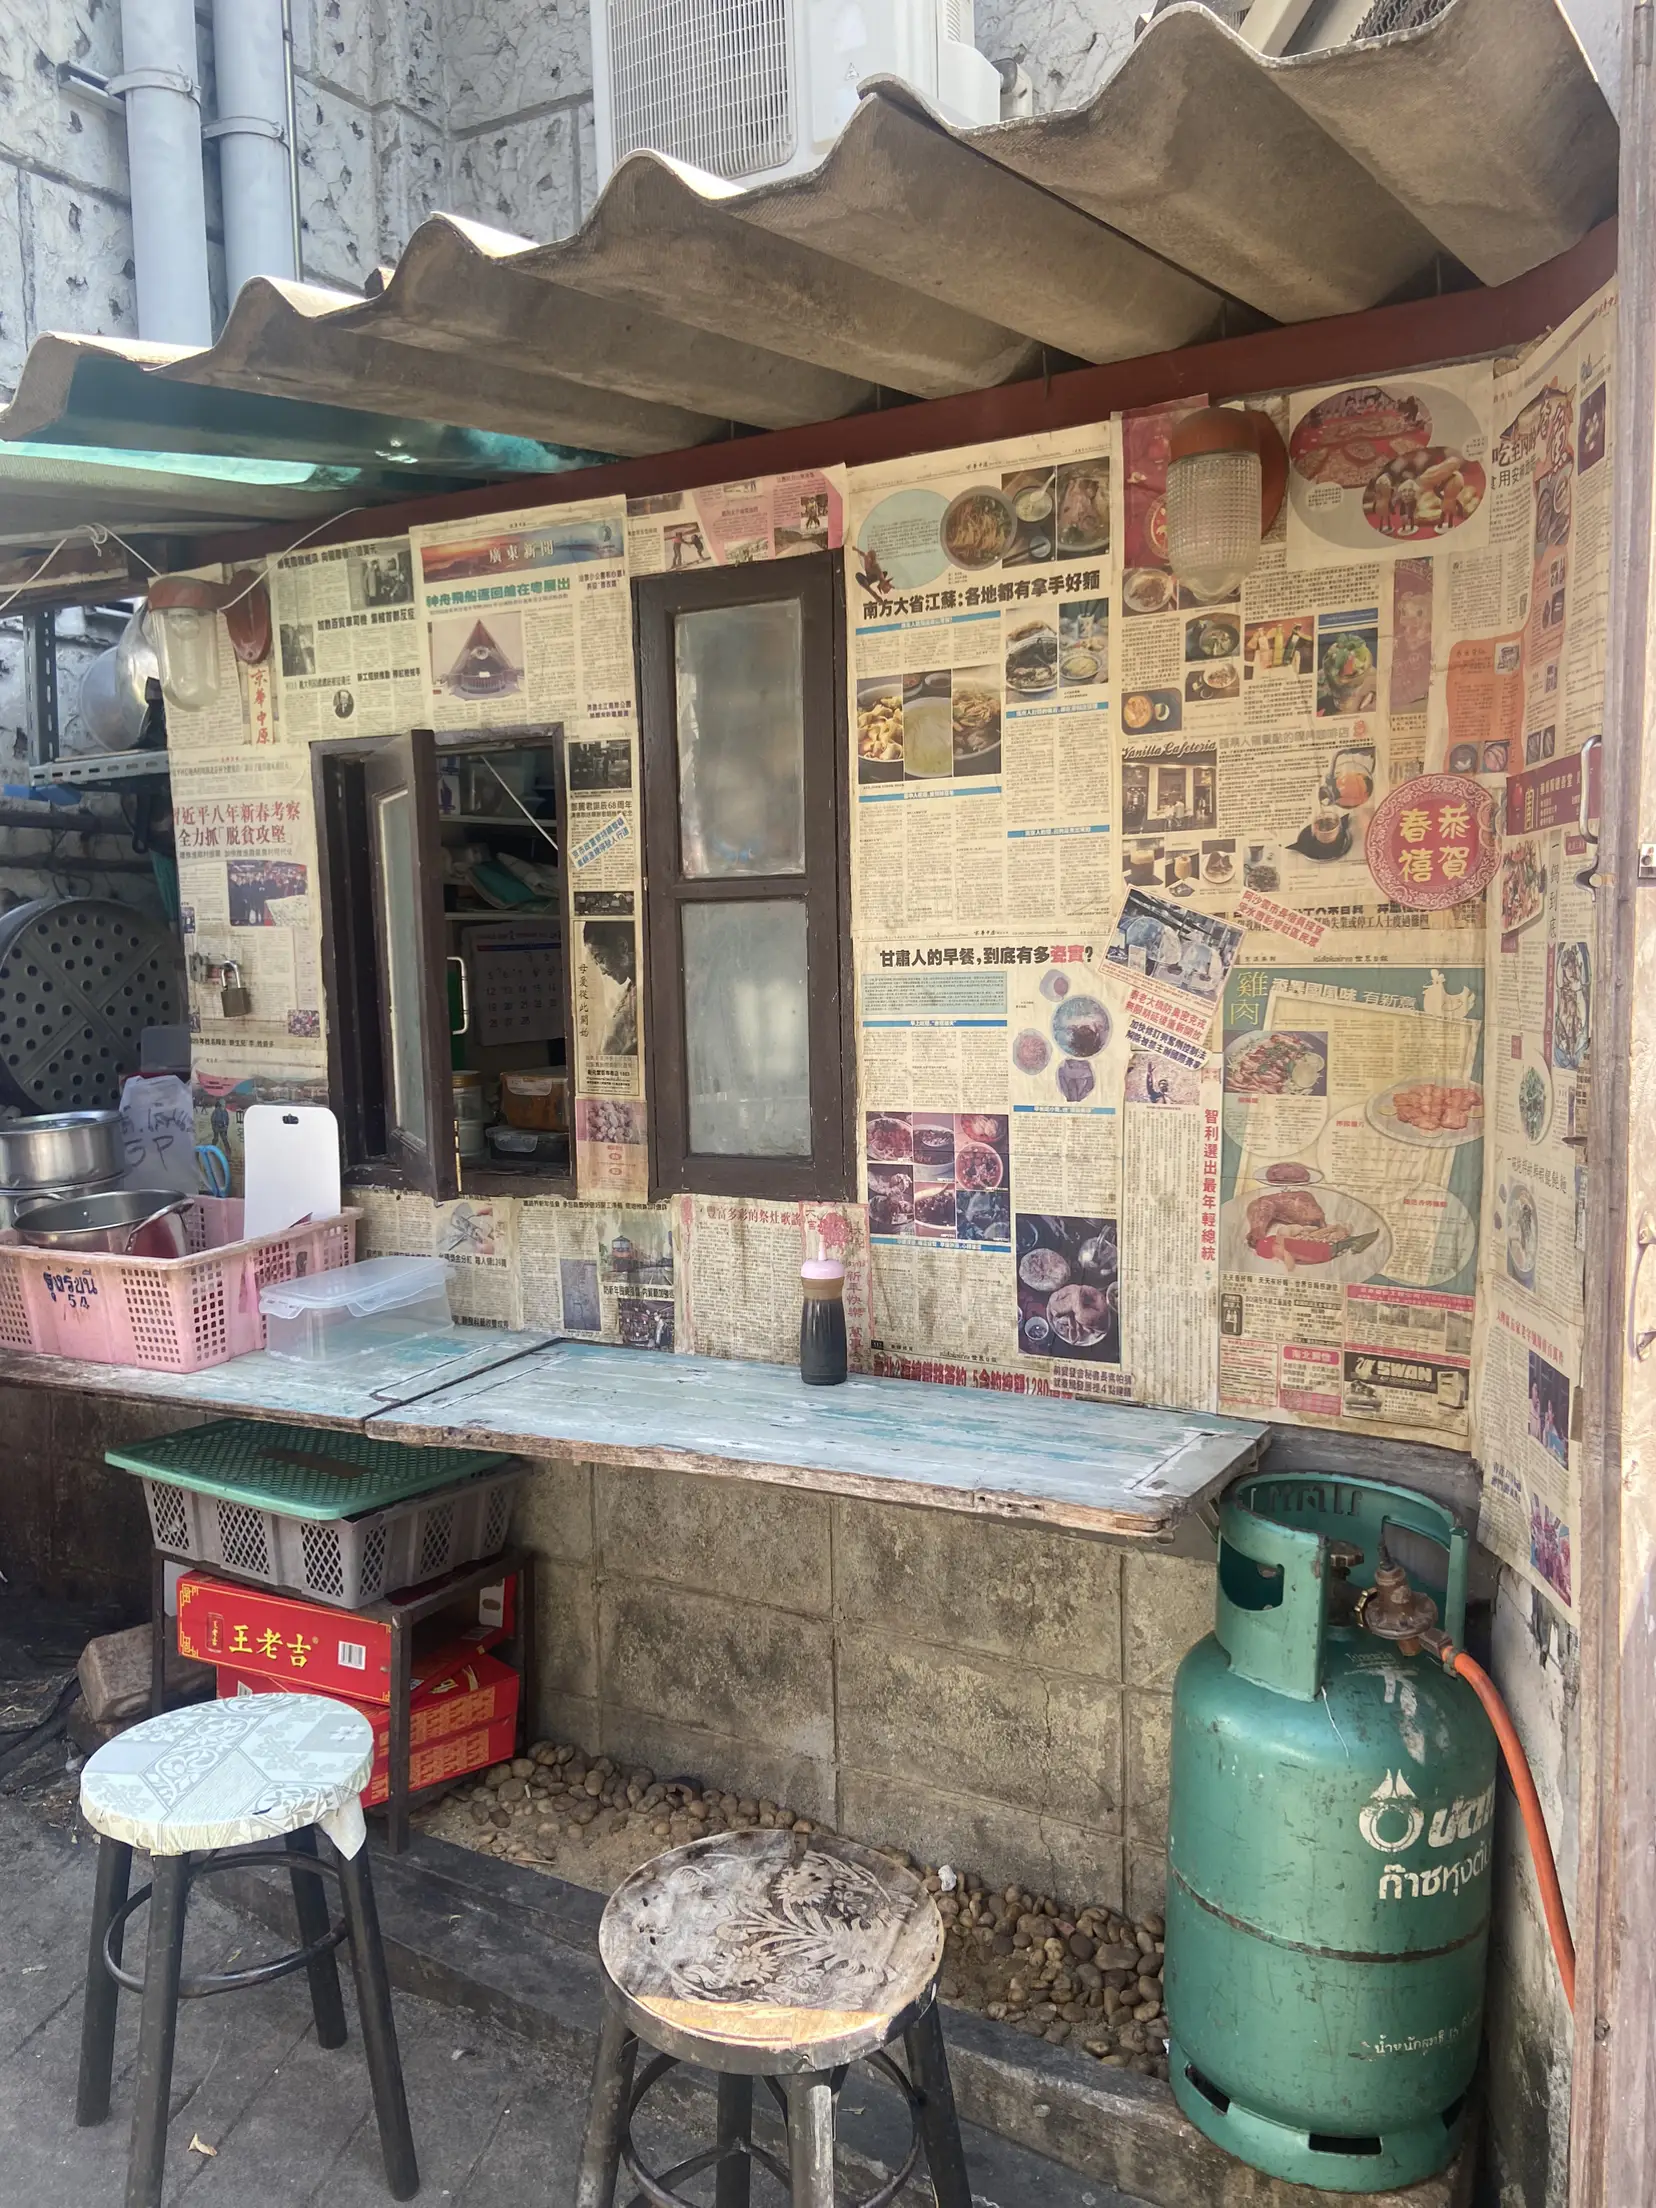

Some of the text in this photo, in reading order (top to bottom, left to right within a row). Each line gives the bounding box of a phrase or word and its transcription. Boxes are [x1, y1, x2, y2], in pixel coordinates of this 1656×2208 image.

[489, 540, 554, 563] 廣東新聞
[249, 668, 270, 745] 京華中原
[1122, 738, 1217, 759] Vanilla Cafeteria
[1229, 971, 1269, 1026] 雞肉
[1200, 1108, 1219, 1262] 智利選出最年輕總統
[1376, 1360, 1433, 1383] SWAN
[228, 1624, 312, 1668] 王老吉
